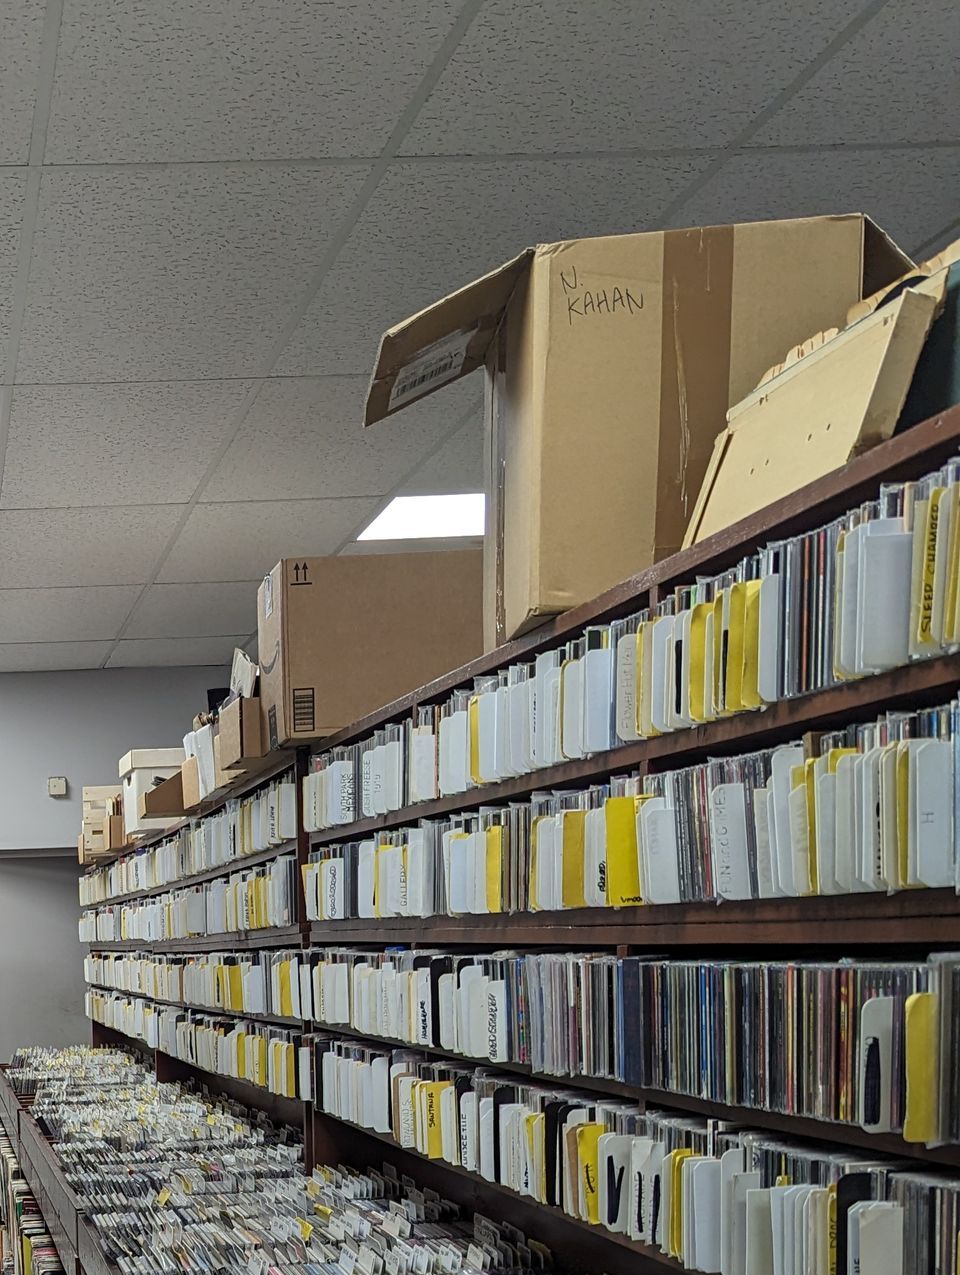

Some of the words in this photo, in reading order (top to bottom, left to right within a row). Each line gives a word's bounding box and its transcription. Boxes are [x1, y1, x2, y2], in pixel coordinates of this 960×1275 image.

[560, 265, 583, 295] N.
[568, 287, 644, 326] KAHAN
[428, 1091, 436, 1129] SANTANA
